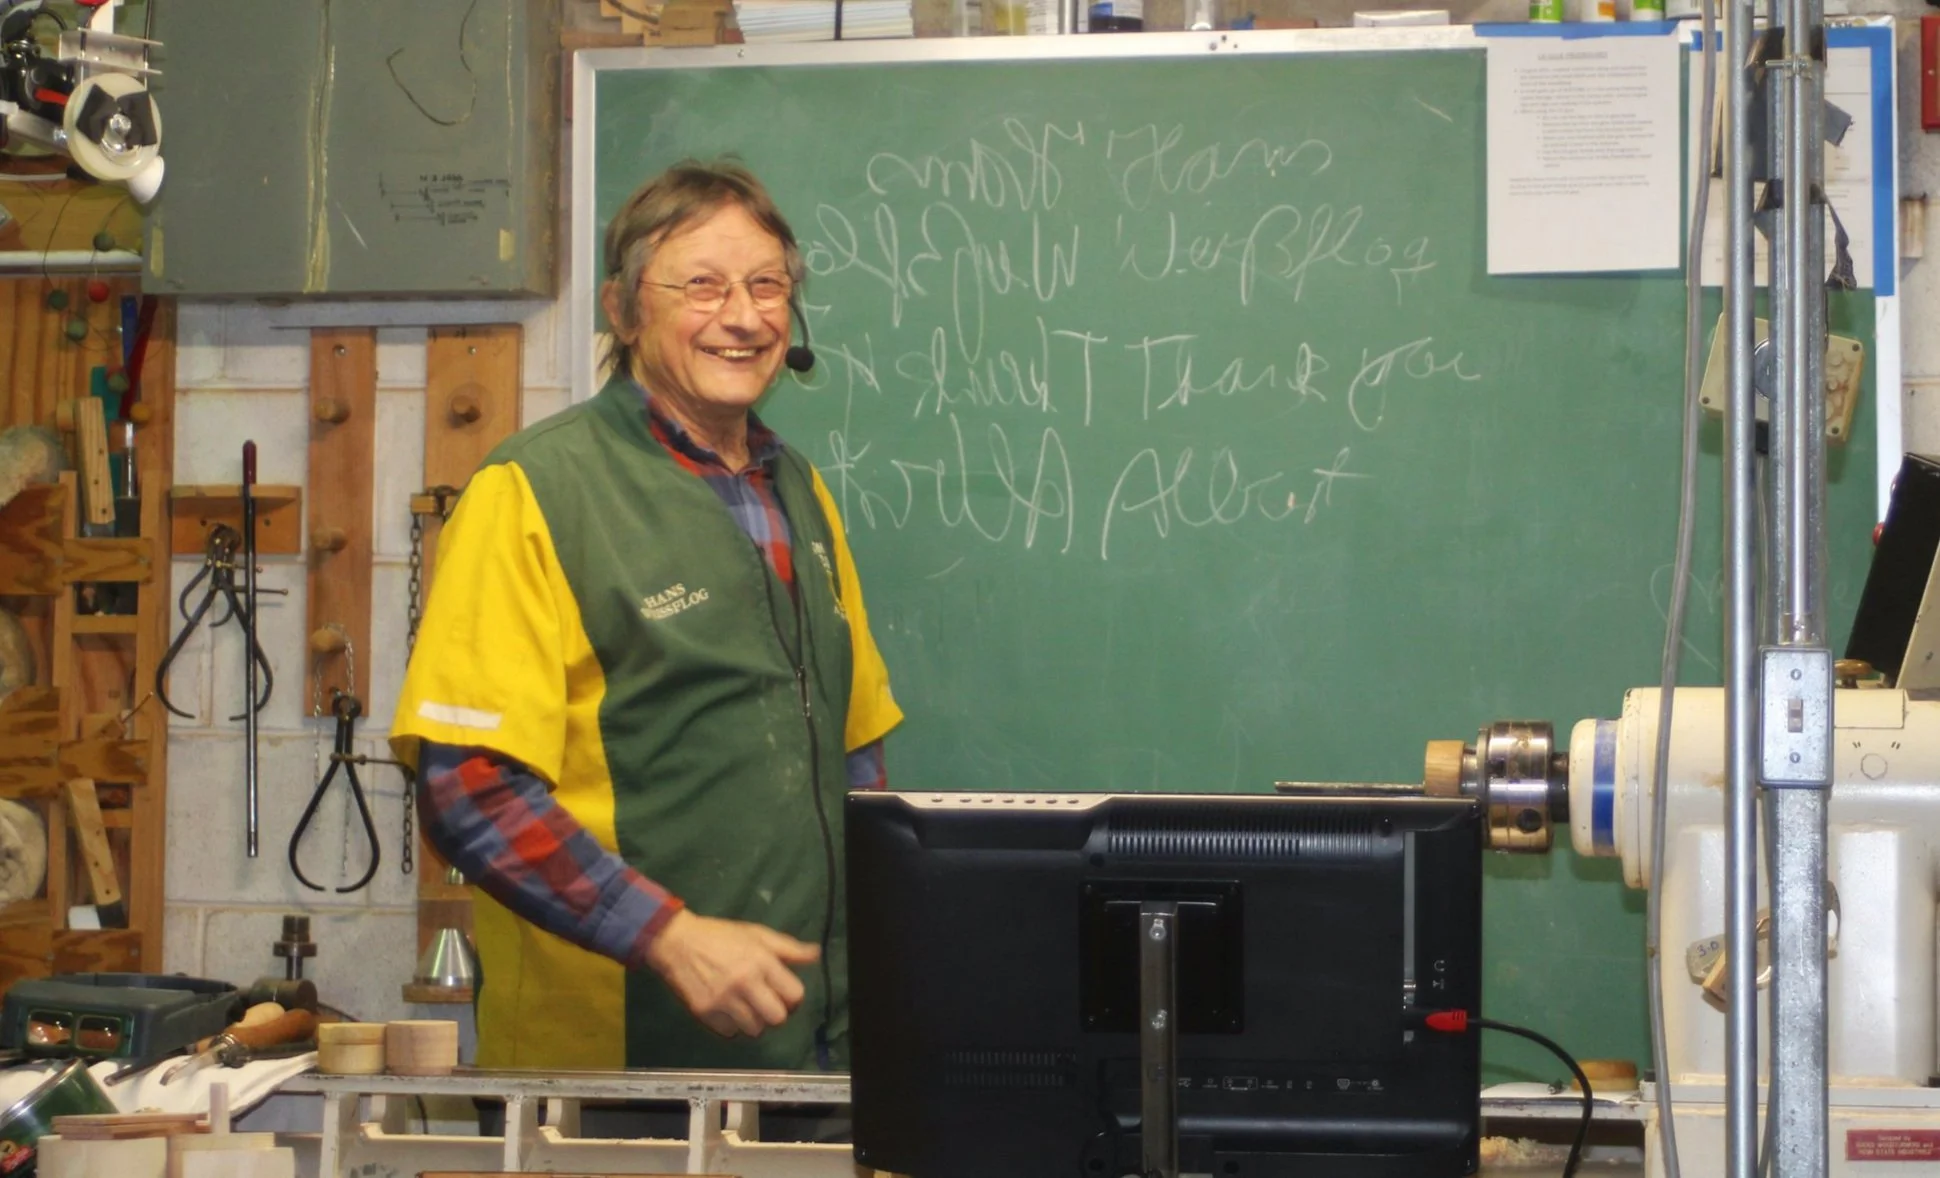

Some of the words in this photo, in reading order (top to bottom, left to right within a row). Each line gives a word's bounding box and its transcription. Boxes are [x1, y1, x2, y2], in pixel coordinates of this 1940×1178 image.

[1106, 122, 1334, 212] Hans
[1124, 334, 1329, 421] Thank
[1348, 335, 1482, 432] you
[643, 582, 687, 609] HANS
